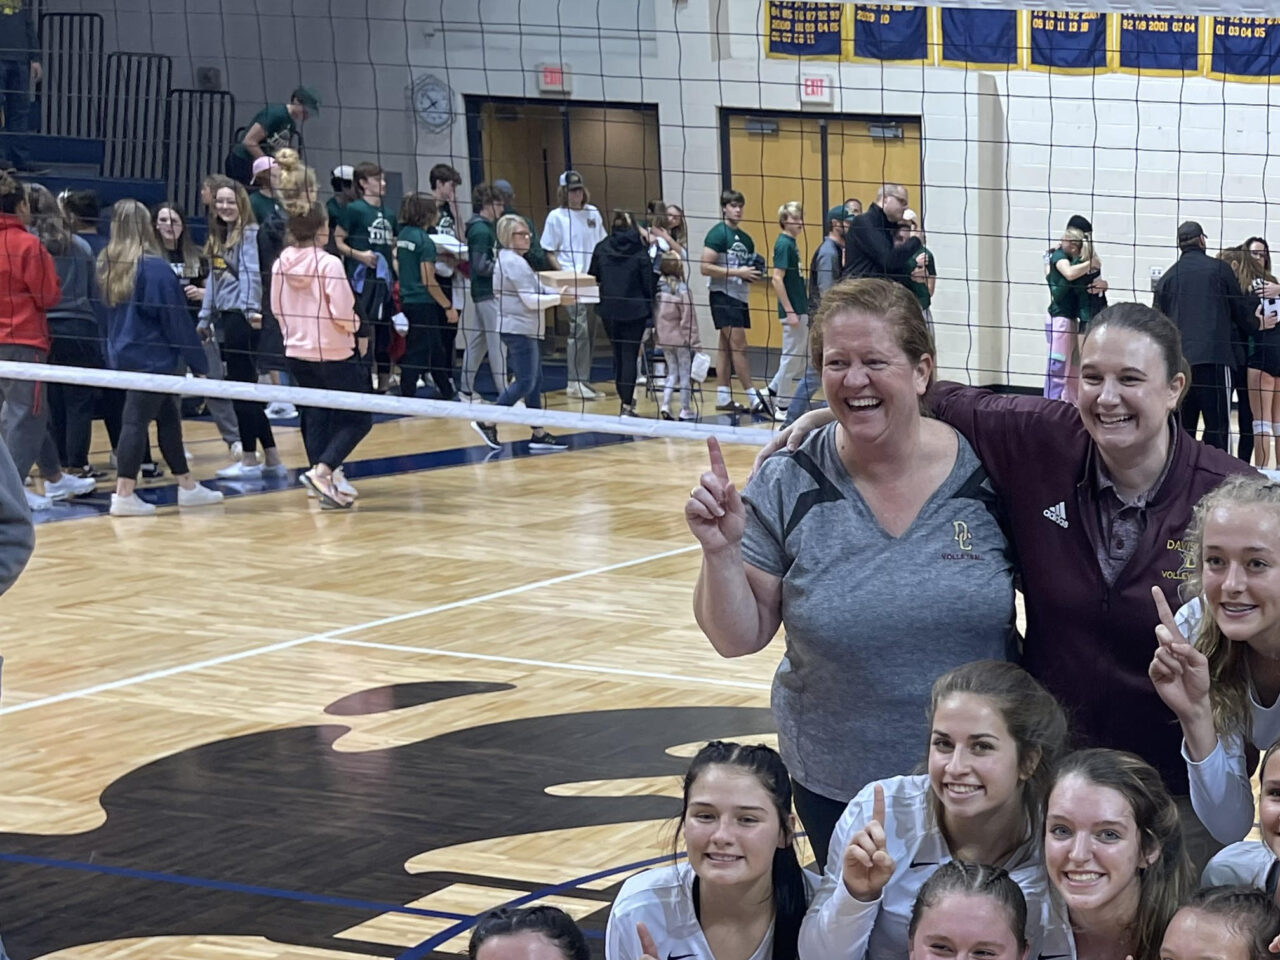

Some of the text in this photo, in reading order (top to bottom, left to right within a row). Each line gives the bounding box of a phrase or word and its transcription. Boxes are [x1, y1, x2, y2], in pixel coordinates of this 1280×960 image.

[1149, 21, 1168, 32] 2001
[1184, 23, 1195, 33] 04
[1216, 25, 1225, 35] 01
[1241, 28, 1252, 38] 04
[1254, 28, 1266, 38] 05
[804, 78, 824, 96] EXIT
